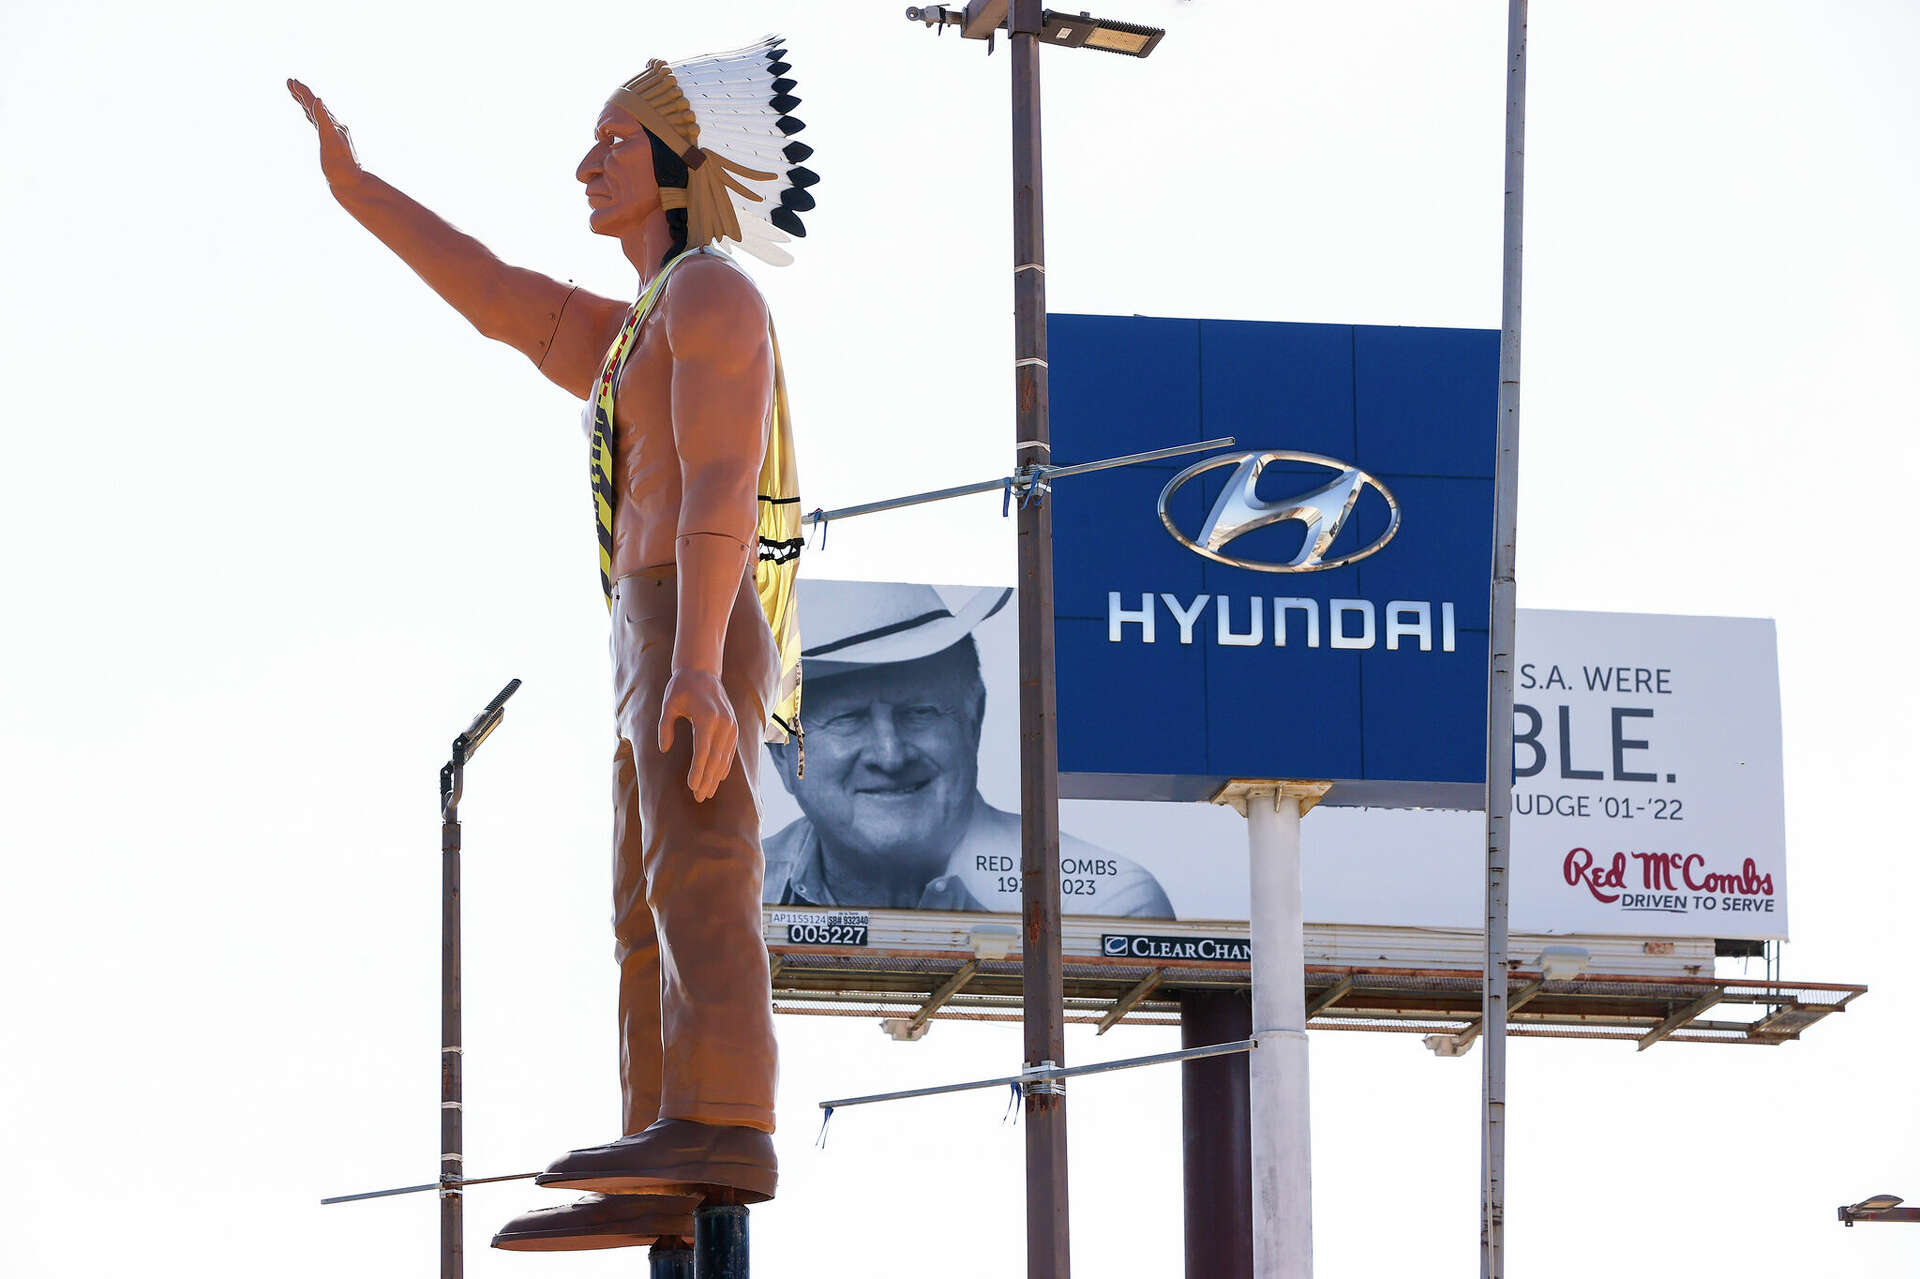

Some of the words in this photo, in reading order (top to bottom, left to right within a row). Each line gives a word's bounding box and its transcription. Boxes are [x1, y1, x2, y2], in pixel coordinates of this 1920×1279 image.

[1108, 591, 1455, 652] HYUNDAI
[1520, 663, 1573, 690] S.A.
[1583, 666, 1673, 694] WERE
[1513, 703, 1677, 783] BLE.
[1516, 794, 1591, 817] UDGE
[976, 855, 1014, 872] RED
[1061, 858, 1118, 876] OMBS
[1563, 847, 1628, 903] Red
[1631, 851, 1774, 896] McCombs
[1621, 893, 1688, 909] DRIVEN
[1693, 896, 1717, 911] TO
[1722, 896, 1775, 912] SERVE
[790, 925, 866, 944] 005227
